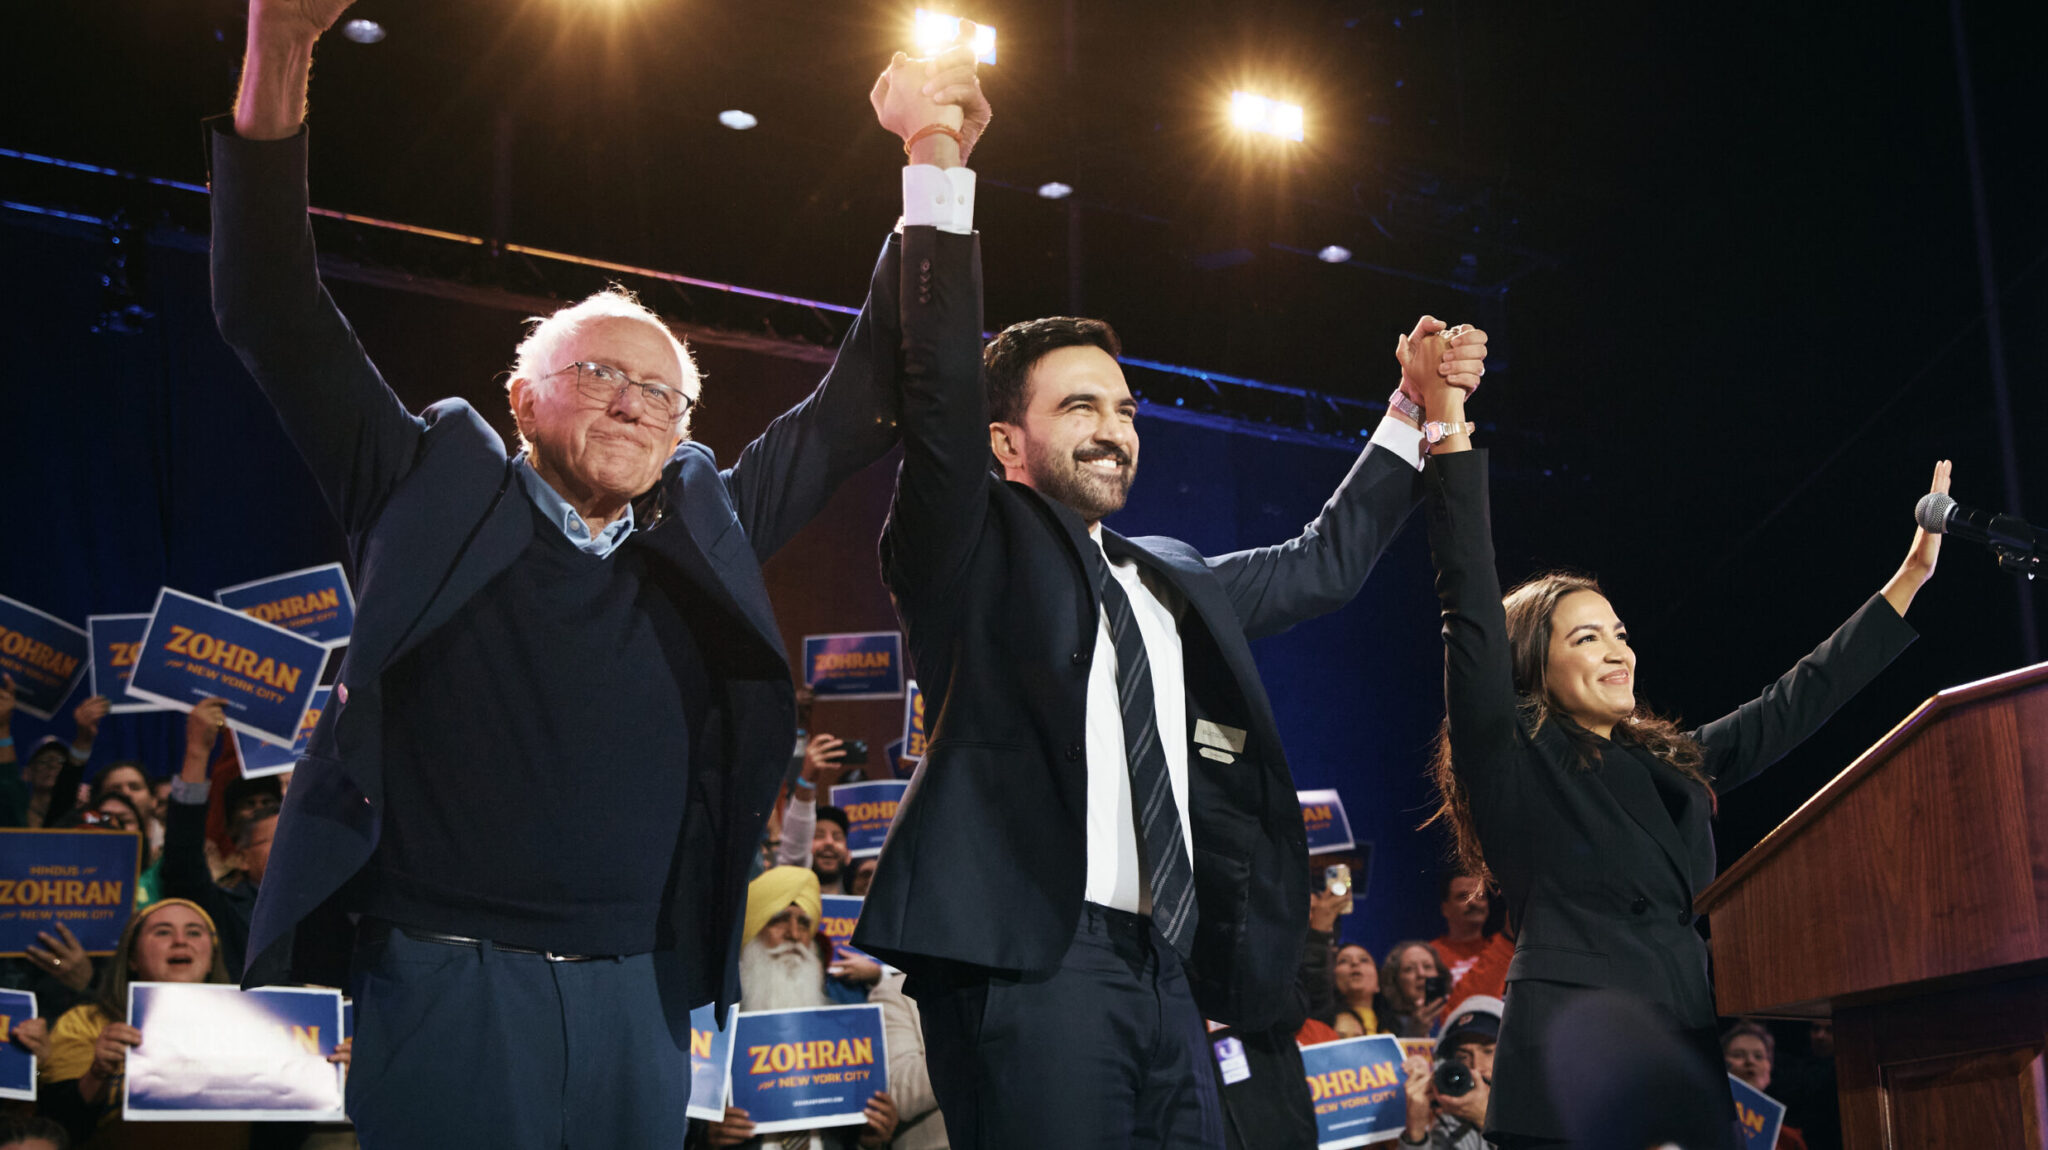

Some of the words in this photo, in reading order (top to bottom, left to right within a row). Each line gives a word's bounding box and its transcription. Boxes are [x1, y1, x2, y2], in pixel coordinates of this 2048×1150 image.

[164, 625, 302, 693] ZOHRAN
[814, 651, 890, 672] ZOHRAN
[186, 663, 220, 682] NEW
[221, 674, 255, 695] YORK
[256, 685, 286, 705] CITY
[0, 879, 123, 906] ZOHRAN
[21, 910, 53, 919] NEW
[56, 910, 89, 919] YORK
[92, 910, 115, 919] CITY
[747, 1037, 874, 1075] ZOHRAN
[778, 1075, 810, 1088] NEW
[812, 1072, 842, 1085] YORK
[844, 1070, 870, 1082] CITY
[1340, 1096, 1370, 1109] YORK
[1371, 1090, 1397, 1103] CITY
